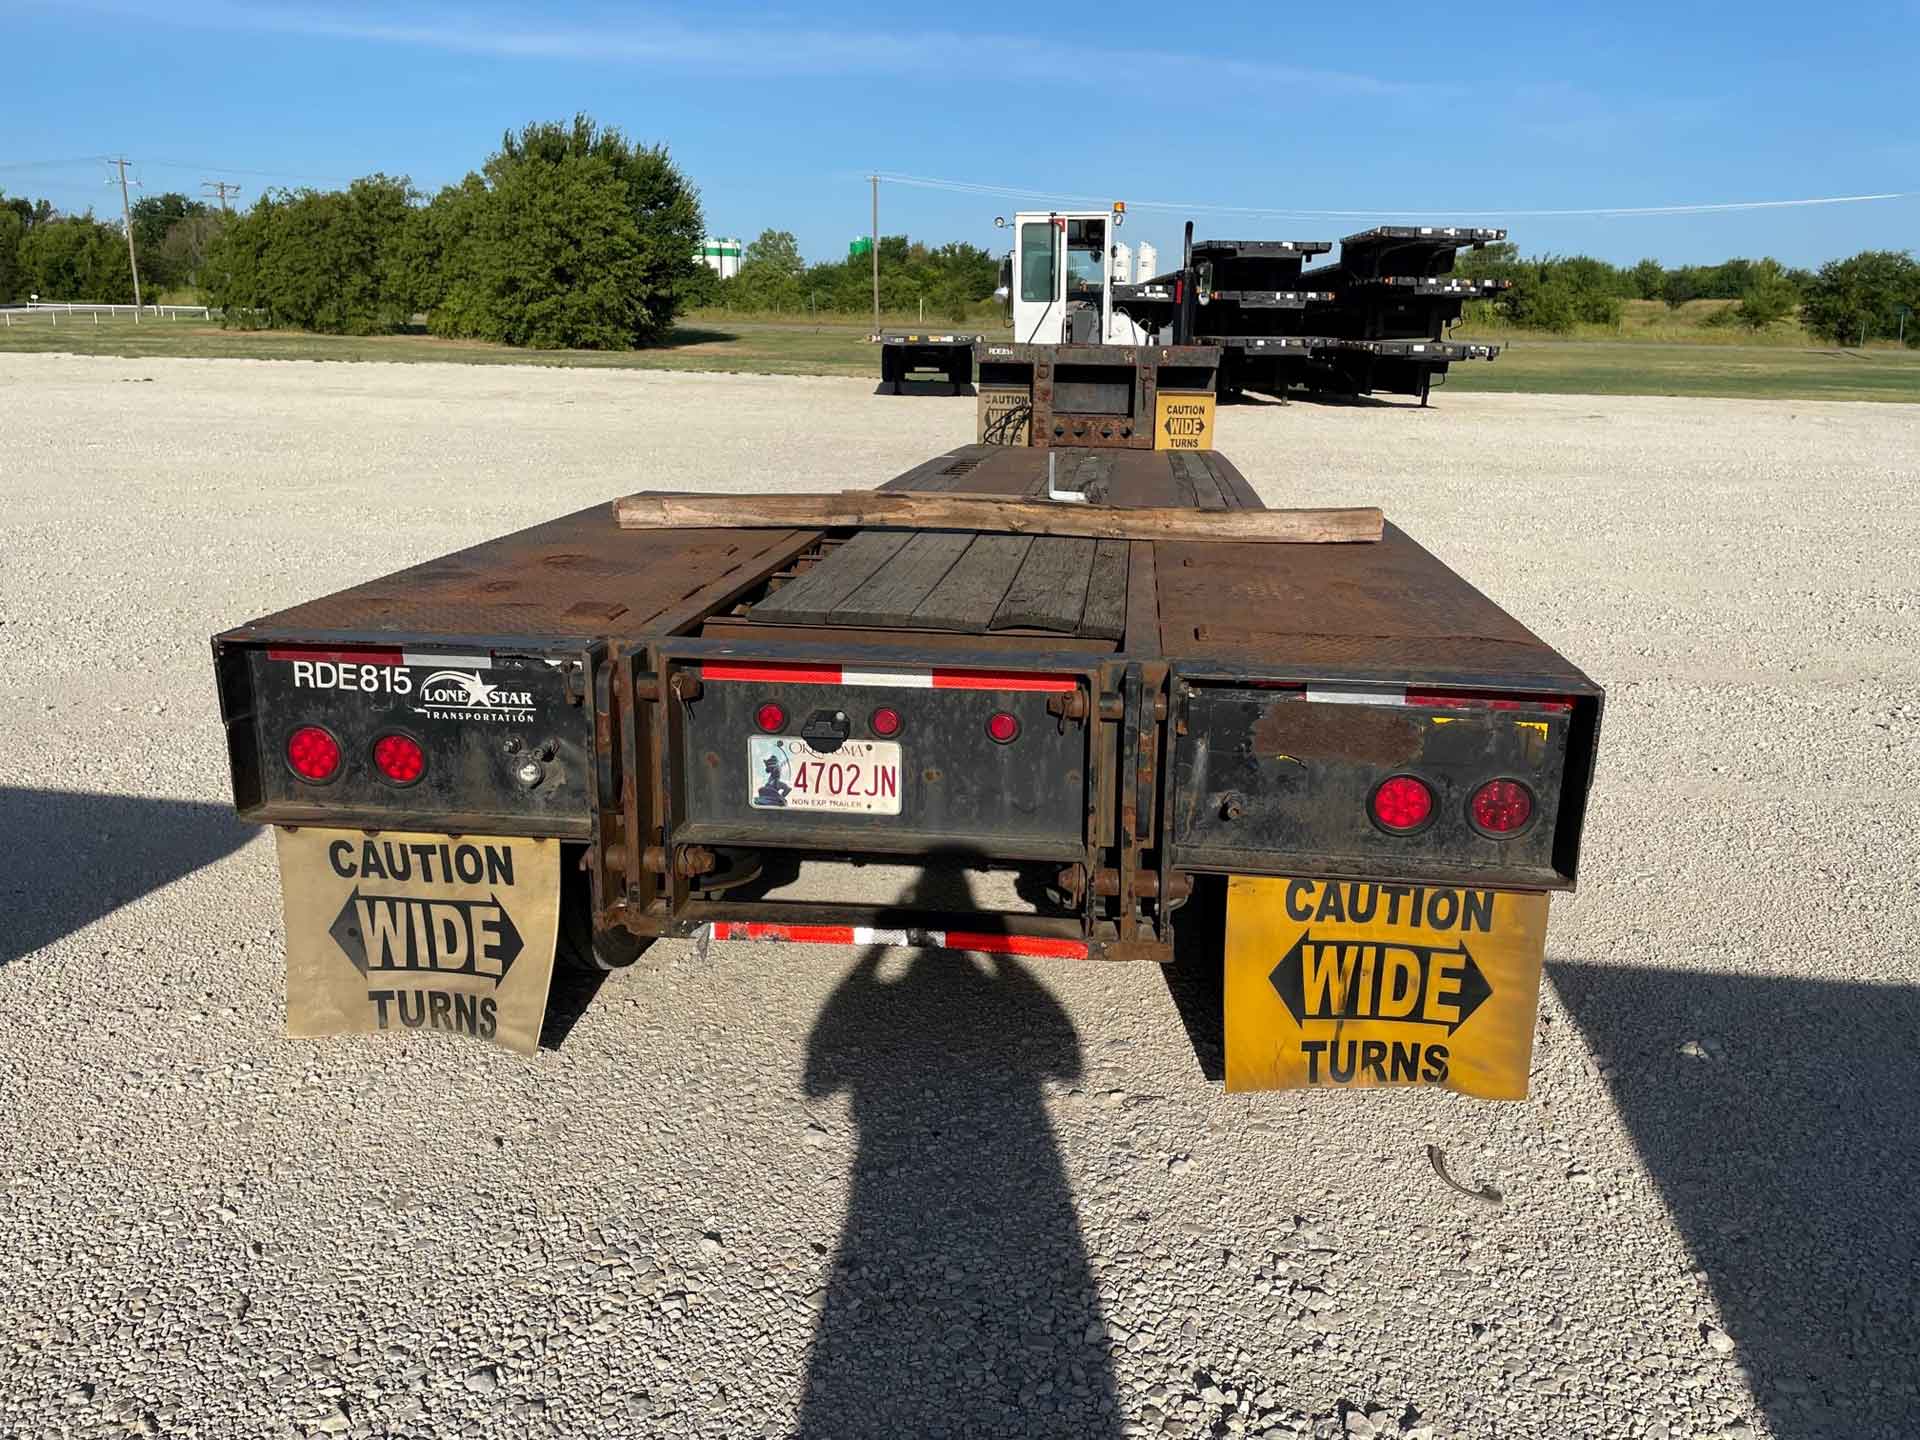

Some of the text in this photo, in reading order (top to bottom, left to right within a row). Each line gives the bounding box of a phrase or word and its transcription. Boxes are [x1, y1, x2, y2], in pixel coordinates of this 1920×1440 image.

[1167, 405, 1205, 415] CAUTION
[1169, 418, 1200, 435] WIDE
[1170, 439, 1199, 448] TURNS
[293, 660, 413, 695] RDE815
[424, 688, 534, 705] LONE STAR
[426, 710, 535, 723] TRANSPORTATION
[793, 761, 897, 798] 4702JN
[791, 798, 810, 806] NON
[829, 800, 862, 808] TRAILER
[328, 839, 515, 885] CAUTION
[1284, 878, 1496, 933] CAUTION
[355, 899, 503, 976] WIDE
[1301, 944, 1467, 1024] WIDE
[367, 990, 498, 1040] TURNS
[1300, 1040, 1450, 1084] TURNS
